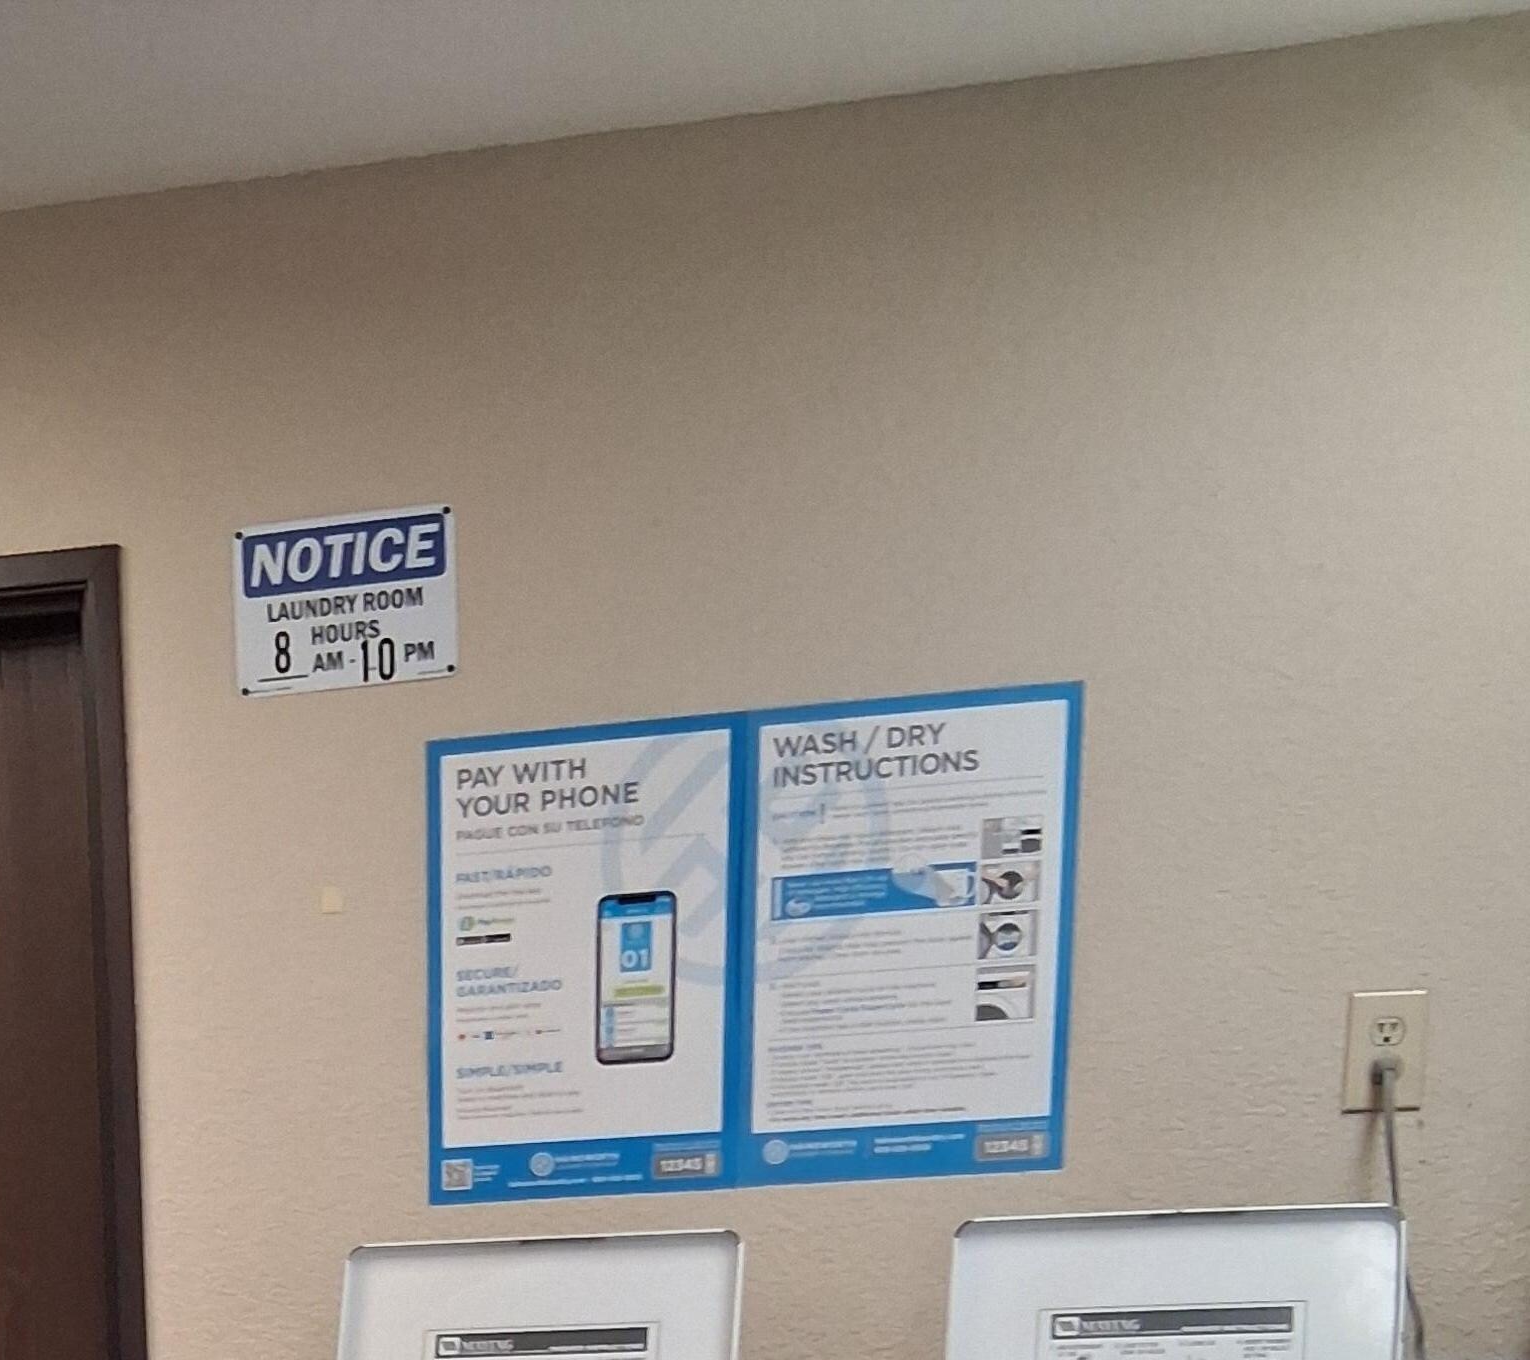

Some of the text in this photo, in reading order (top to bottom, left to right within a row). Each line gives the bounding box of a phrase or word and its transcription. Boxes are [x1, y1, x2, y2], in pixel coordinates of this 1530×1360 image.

[250, 522, 440, 587] NOTICE
[267, 587, 423, 622] LAUNDRY ROOM
[311, 619, 381, 645] HOURS
[274, 631, 291, 674] 8
[312, 651, 344, 673] AM
[361, 637, 395, 682] 10
[404, 640, 435, 662] PM
[772, 730, 858, 758] WASH
[886, 722, 947, 749] DRY
[456, 758, 587, 790] PAY WITH
[772, 750, 980, 788] INSTRUCTIONS
[456, 781, 639, 818] YOUR PHONE
[456, 825, 505, 841] PAGUE
[507, 822, 538, 838] CON
[543, 820, 561, 835] SU
[621, 950, 651, 968] 01
